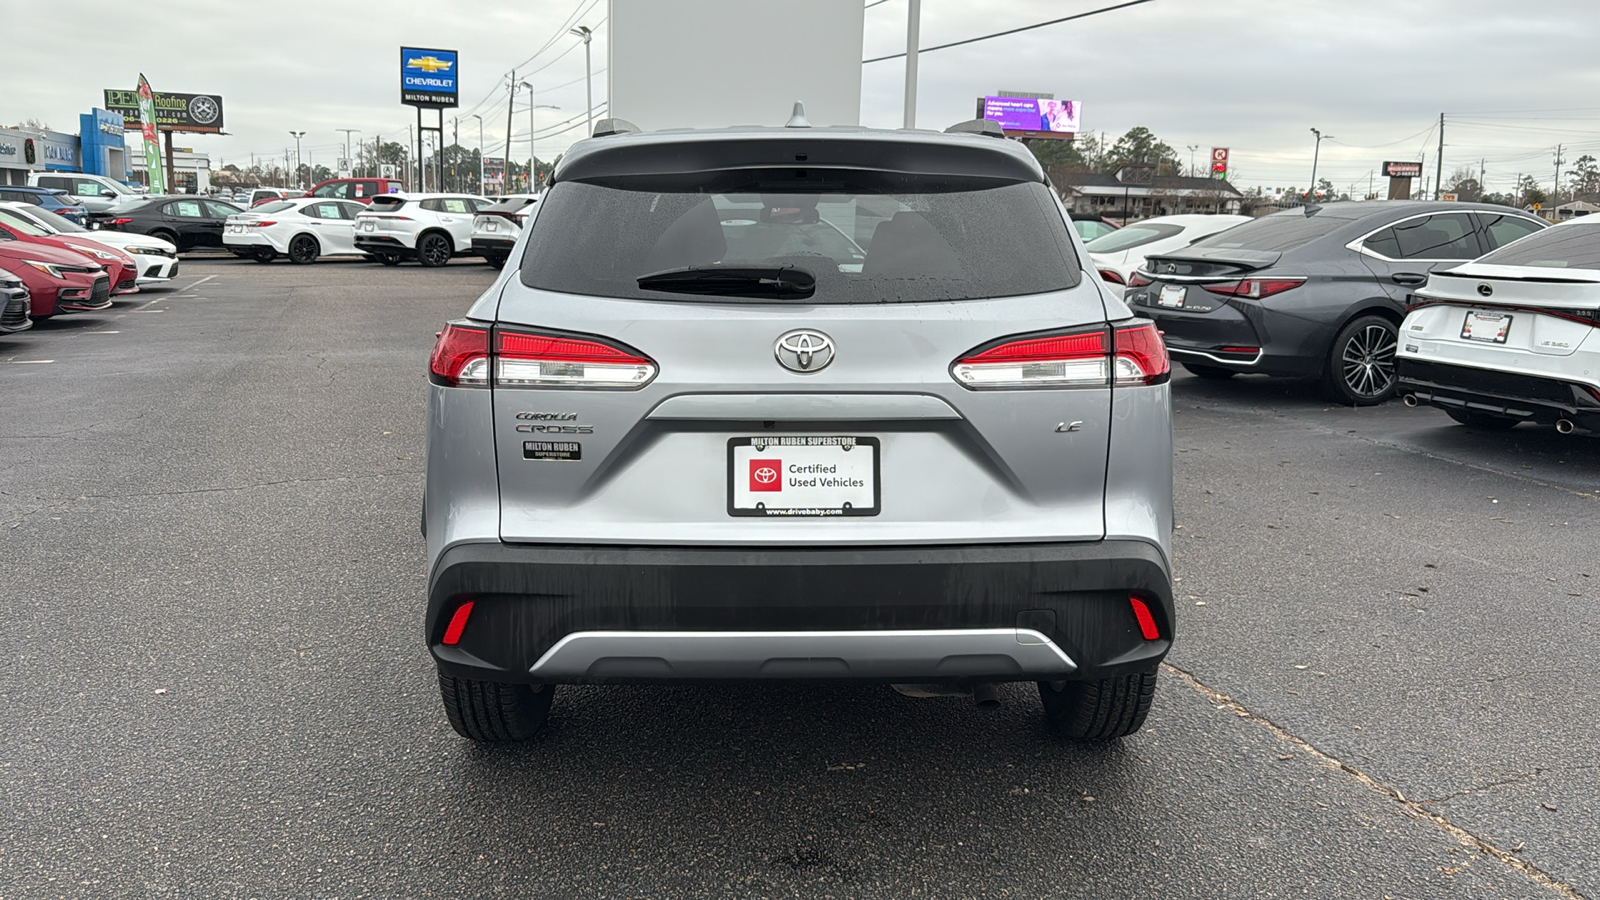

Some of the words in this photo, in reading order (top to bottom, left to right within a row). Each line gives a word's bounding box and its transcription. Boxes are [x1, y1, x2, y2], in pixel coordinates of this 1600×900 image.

[405, 77, 453, 87] CHEVROLET
[155, 95, 187, 109] Roofing
[516, 411, 578, 421] COROLLA
[516, 424, 594, 434] CROSS
[1054, 420, 1083, 433] LE
[751, 437, 779, 446] MILTON
[780, 437, 807, 446] RUBEN
[807, 437, 857, 446] SUPERSTORE
[525, 442, 553, 451] MILTON
[553, 443, 579, 452] RUBEN
[789, 464, 837, 474] Certified
[789, 477, 817, 487] Used
[820, 477, 864, 487] Vehicles
[766, 508, 843, 517] www.drivebaby.com
